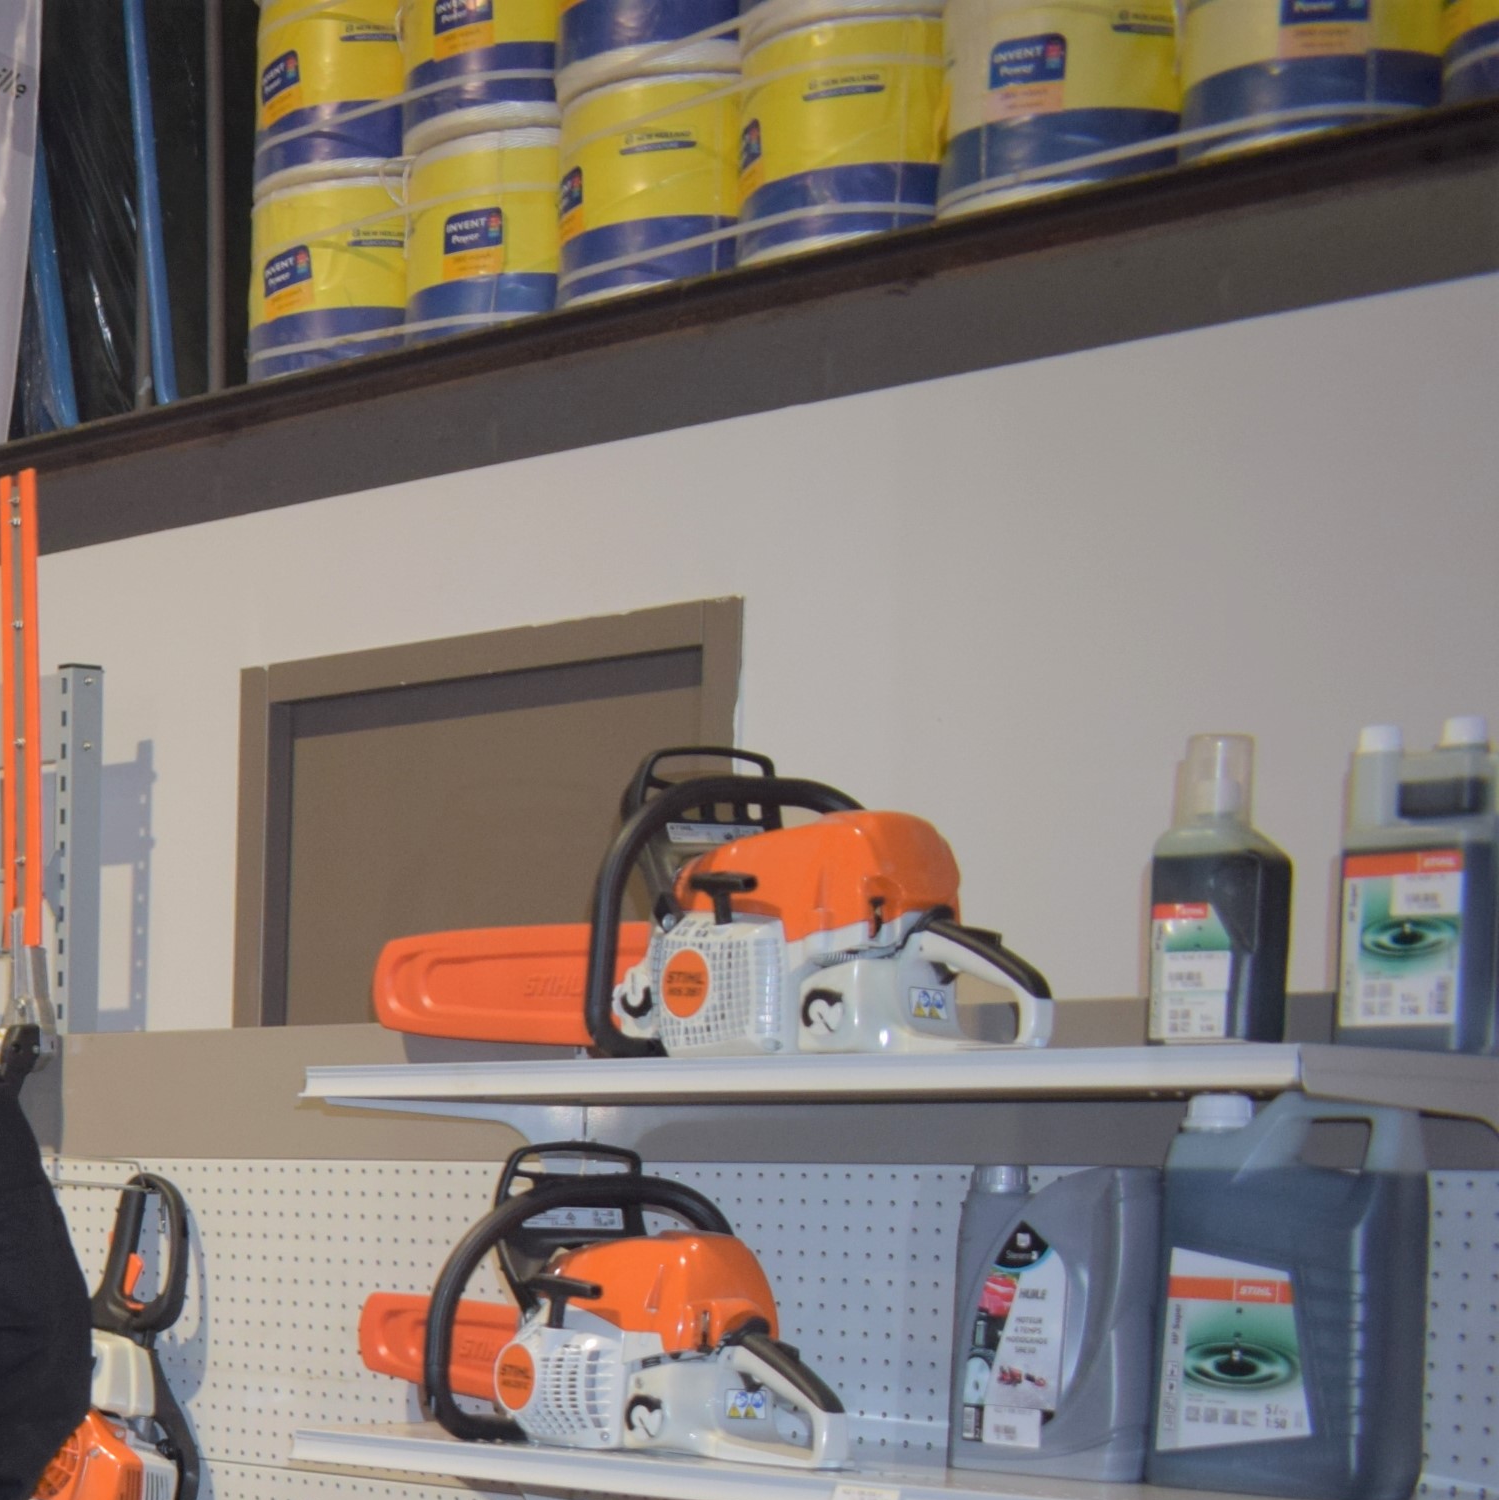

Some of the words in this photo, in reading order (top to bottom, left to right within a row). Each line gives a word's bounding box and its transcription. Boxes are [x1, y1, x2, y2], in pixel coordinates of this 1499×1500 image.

[446, 216, 487, 234] INVENT
[1018, 1289, 1046, 1300] HUILE
[1240, 1285, 1273, 1296] STIHL
